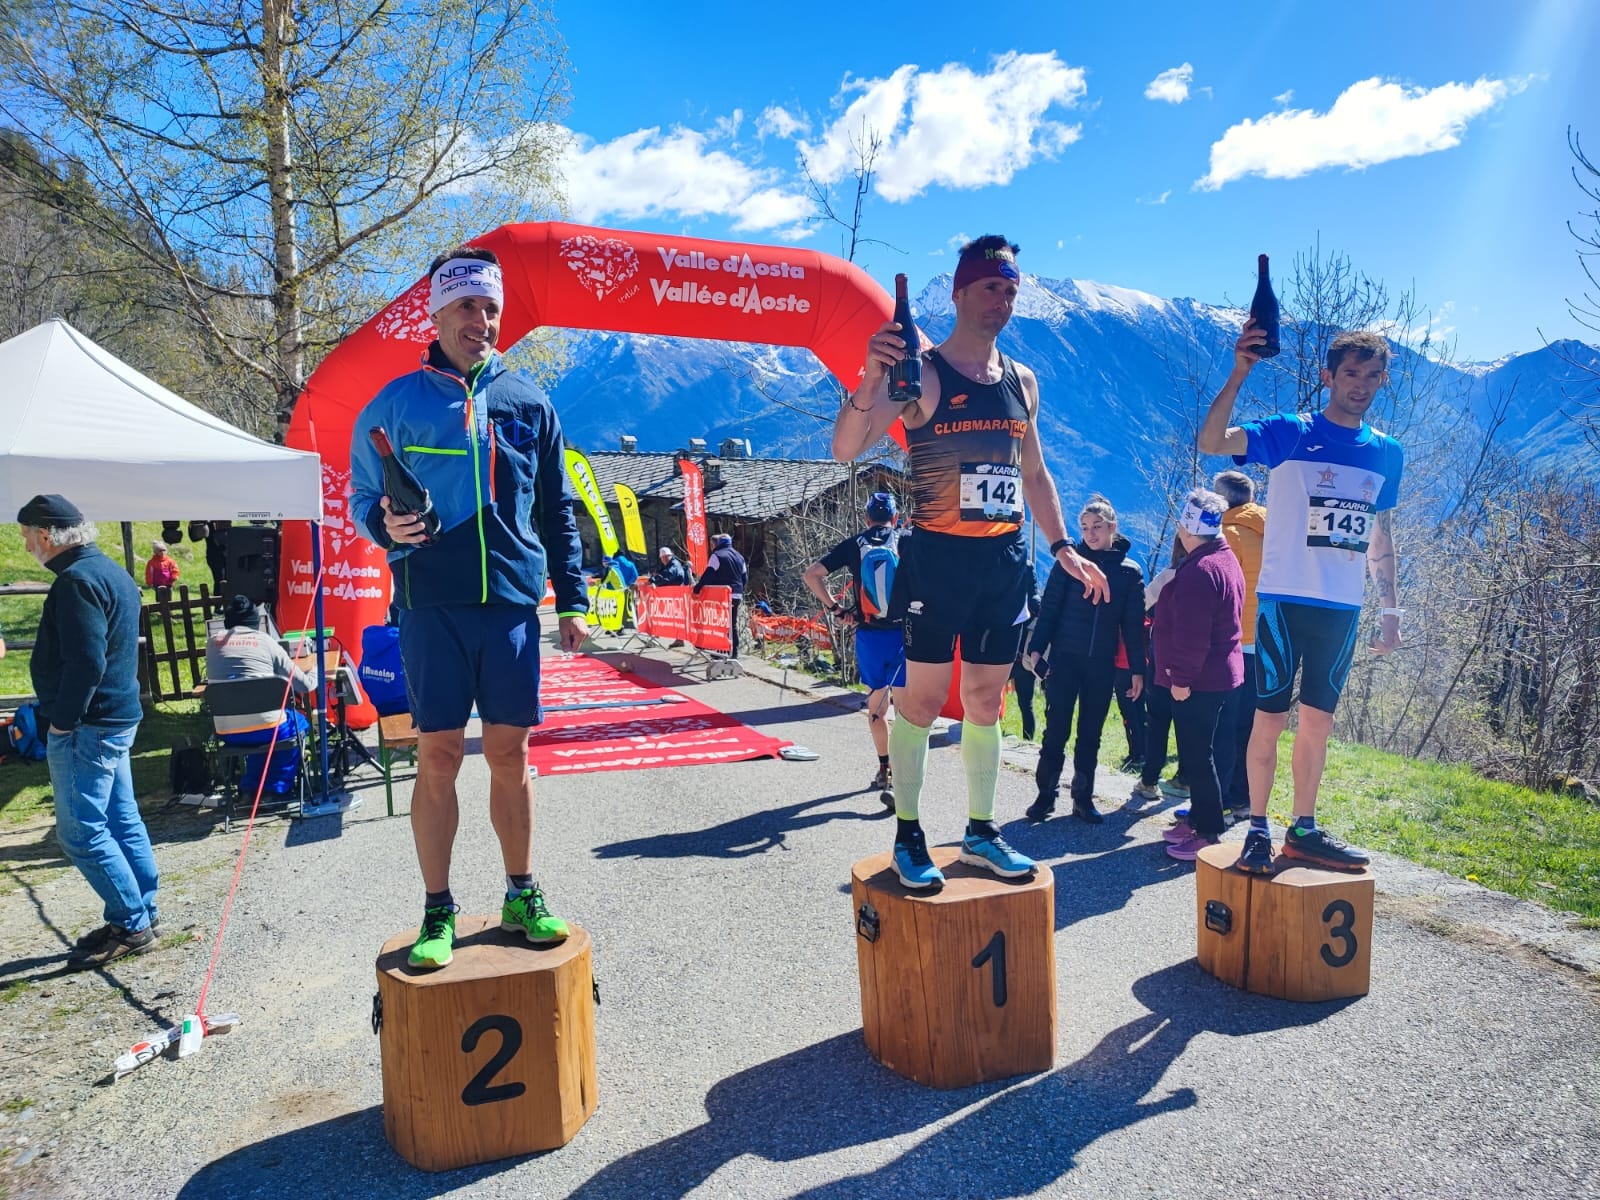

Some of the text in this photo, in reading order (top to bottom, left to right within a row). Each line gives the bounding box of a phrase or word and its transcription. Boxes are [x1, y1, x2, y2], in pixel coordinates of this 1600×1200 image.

[657, 246, 805, 279] Valle d'Aosta
[441, 280, 467, 295] micro
[650, 278, 811, 314] Vallée d'Aoste
[934, 418, 1028, 436] CLUBMARATHO
[977, 480, 1016, 504] 142
[1339, 500, 1369, 511] KARHU
[1323, 512, 1366, 535] 143
[328, 560, 381, 579] d'Aosta
[287, 581, 382, 600] Valle d'Aoste
[1320, 899, 1358, 968] 3
[971, 930, 1007, 1008] 1
[461, 1014, 526, 1107] 2
